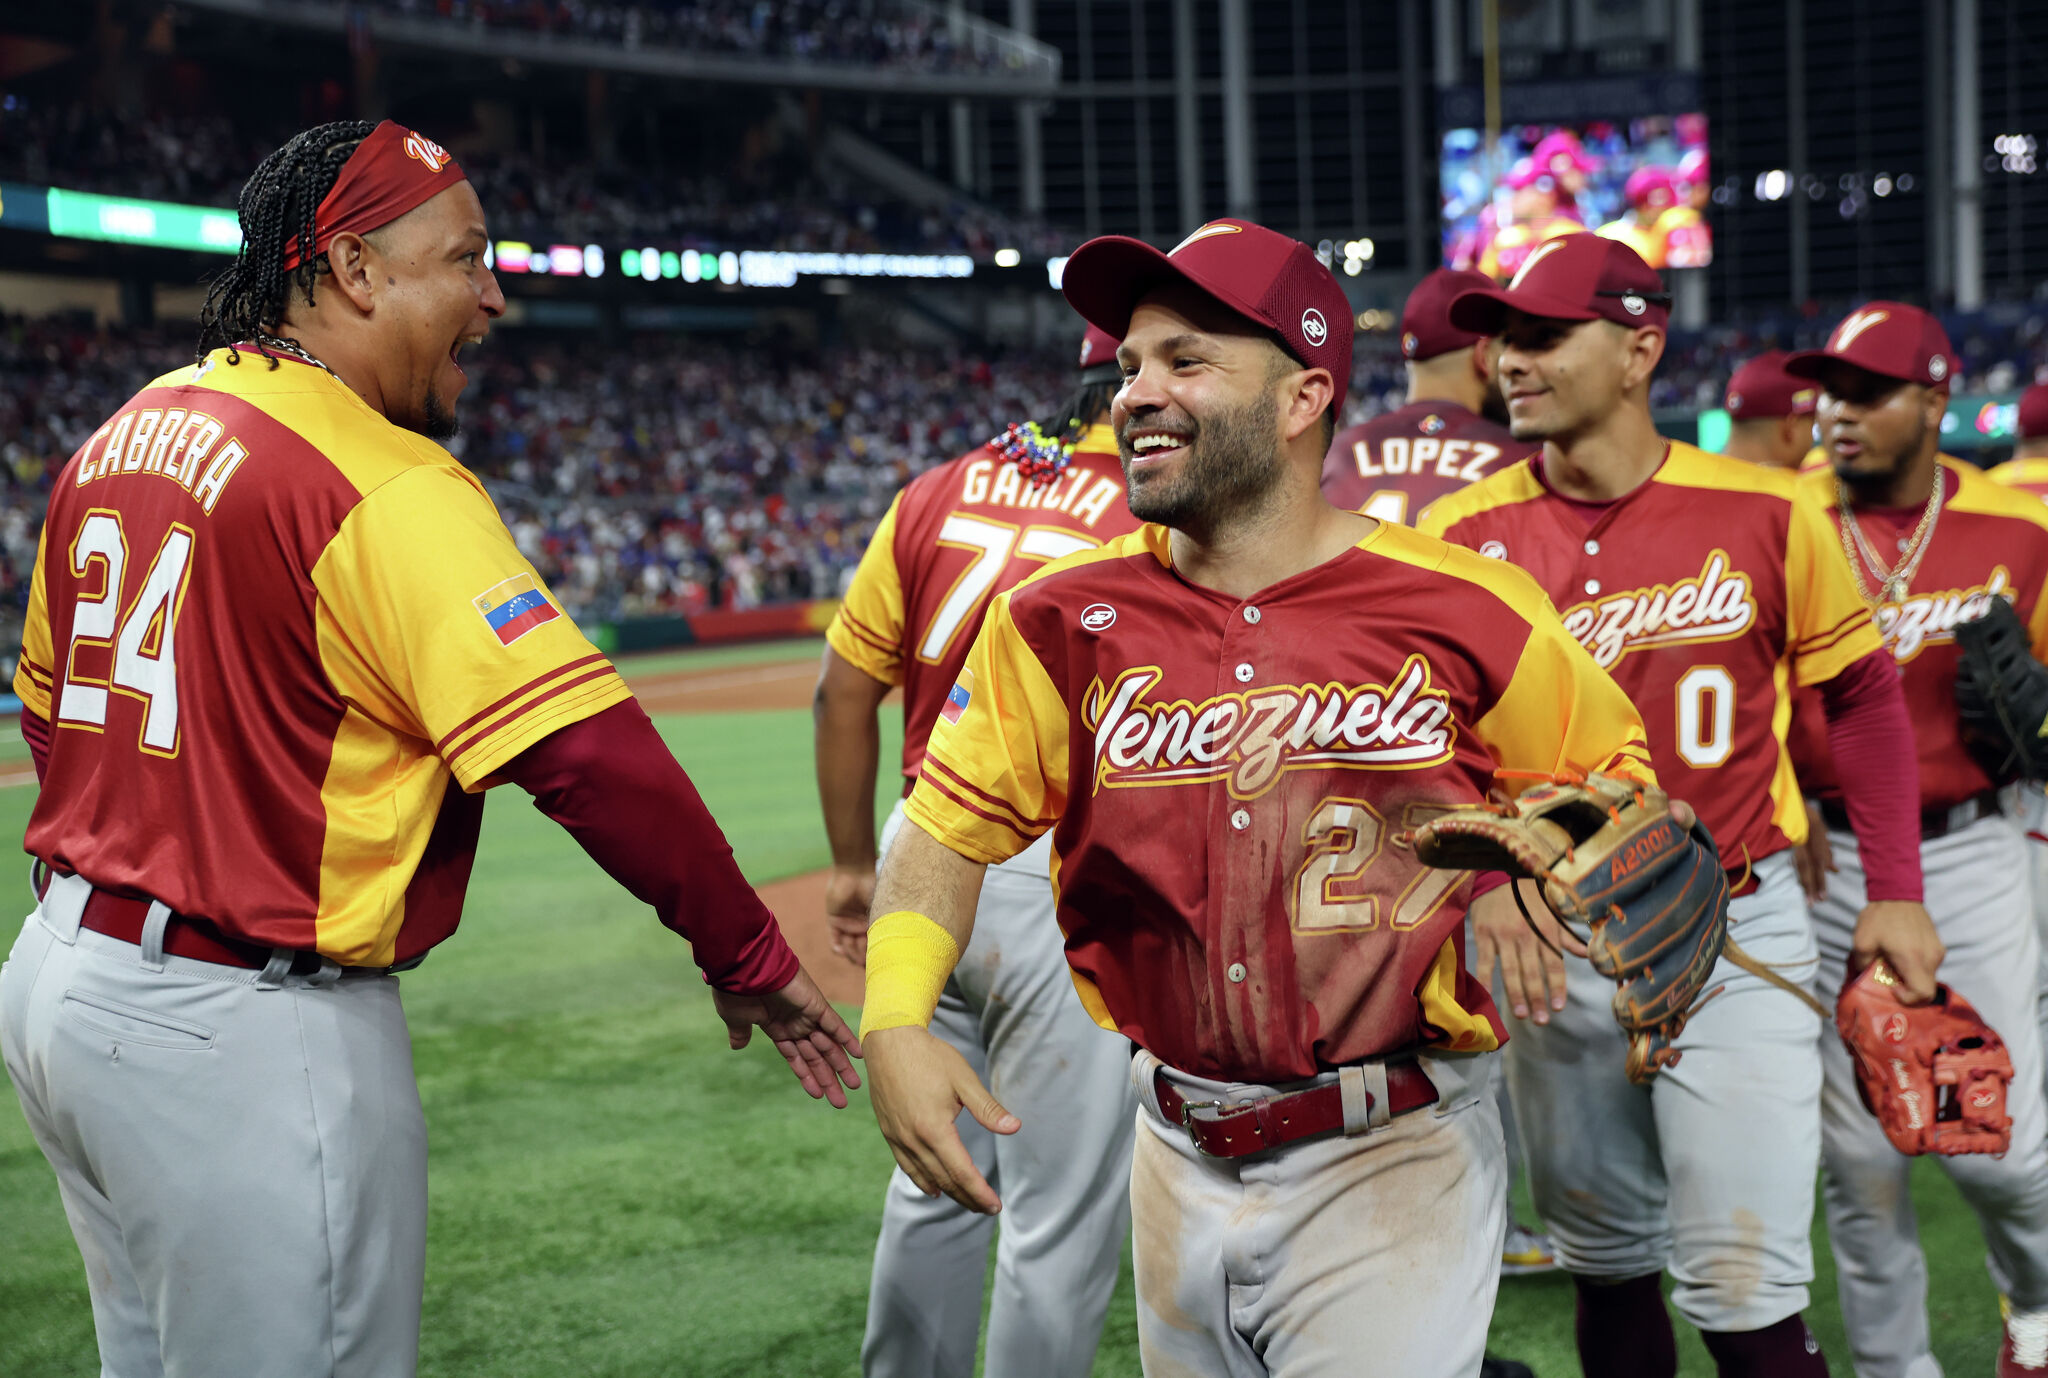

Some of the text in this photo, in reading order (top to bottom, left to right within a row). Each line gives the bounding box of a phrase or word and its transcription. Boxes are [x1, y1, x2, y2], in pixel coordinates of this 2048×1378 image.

[76, 407, 249, 516] CABRERA
[1353, 436, 1502, 482] LOPEZ
[56, 508, 195, 760] 24
[1081, 652, 1457, 801] Venezuela
[1675, 664, 1737, 769] 0
[1611, 823, 1674, 883] A2000
